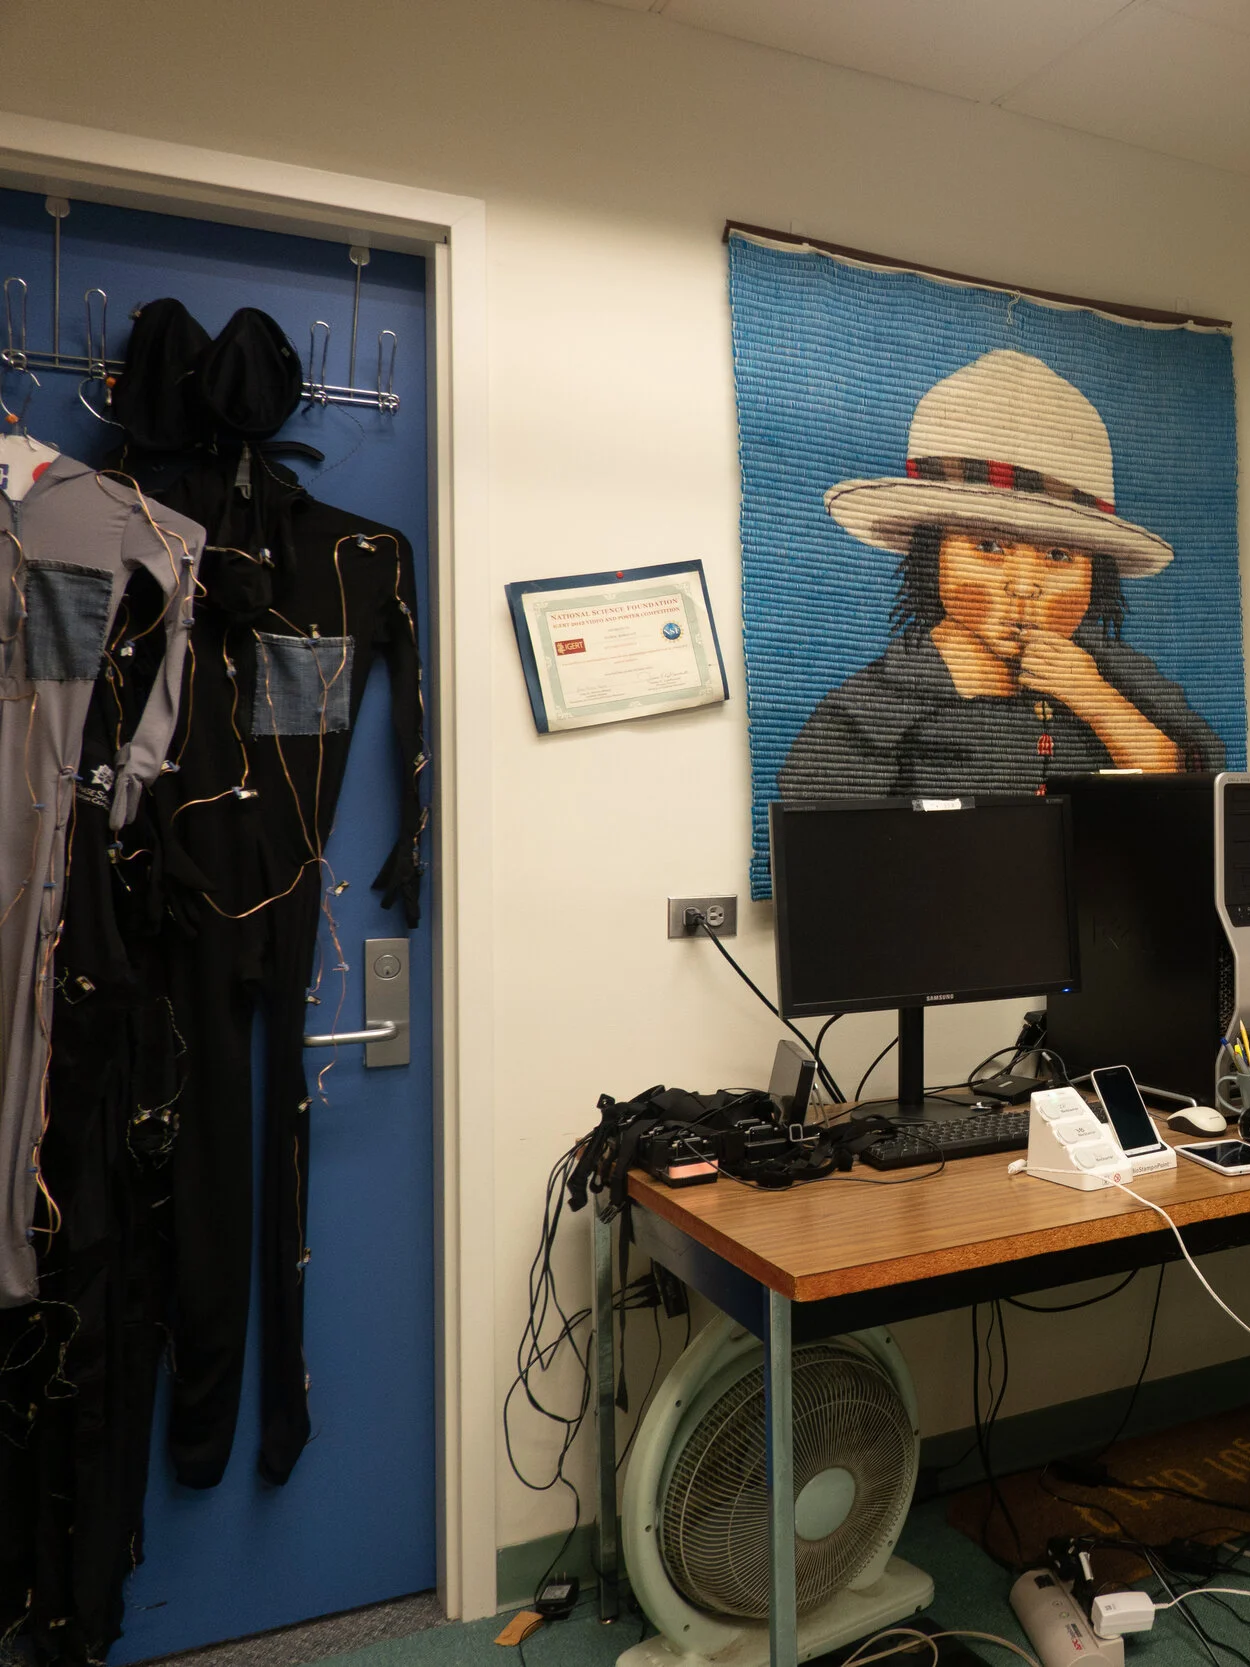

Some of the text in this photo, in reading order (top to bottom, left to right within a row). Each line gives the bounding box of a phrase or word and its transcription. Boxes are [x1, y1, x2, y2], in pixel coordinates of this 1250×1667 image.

[551, 598, 678, 621] NATIONAL SCIENCE FOUNDATION
[927, 993, 954, 1001] SAMSUNG
